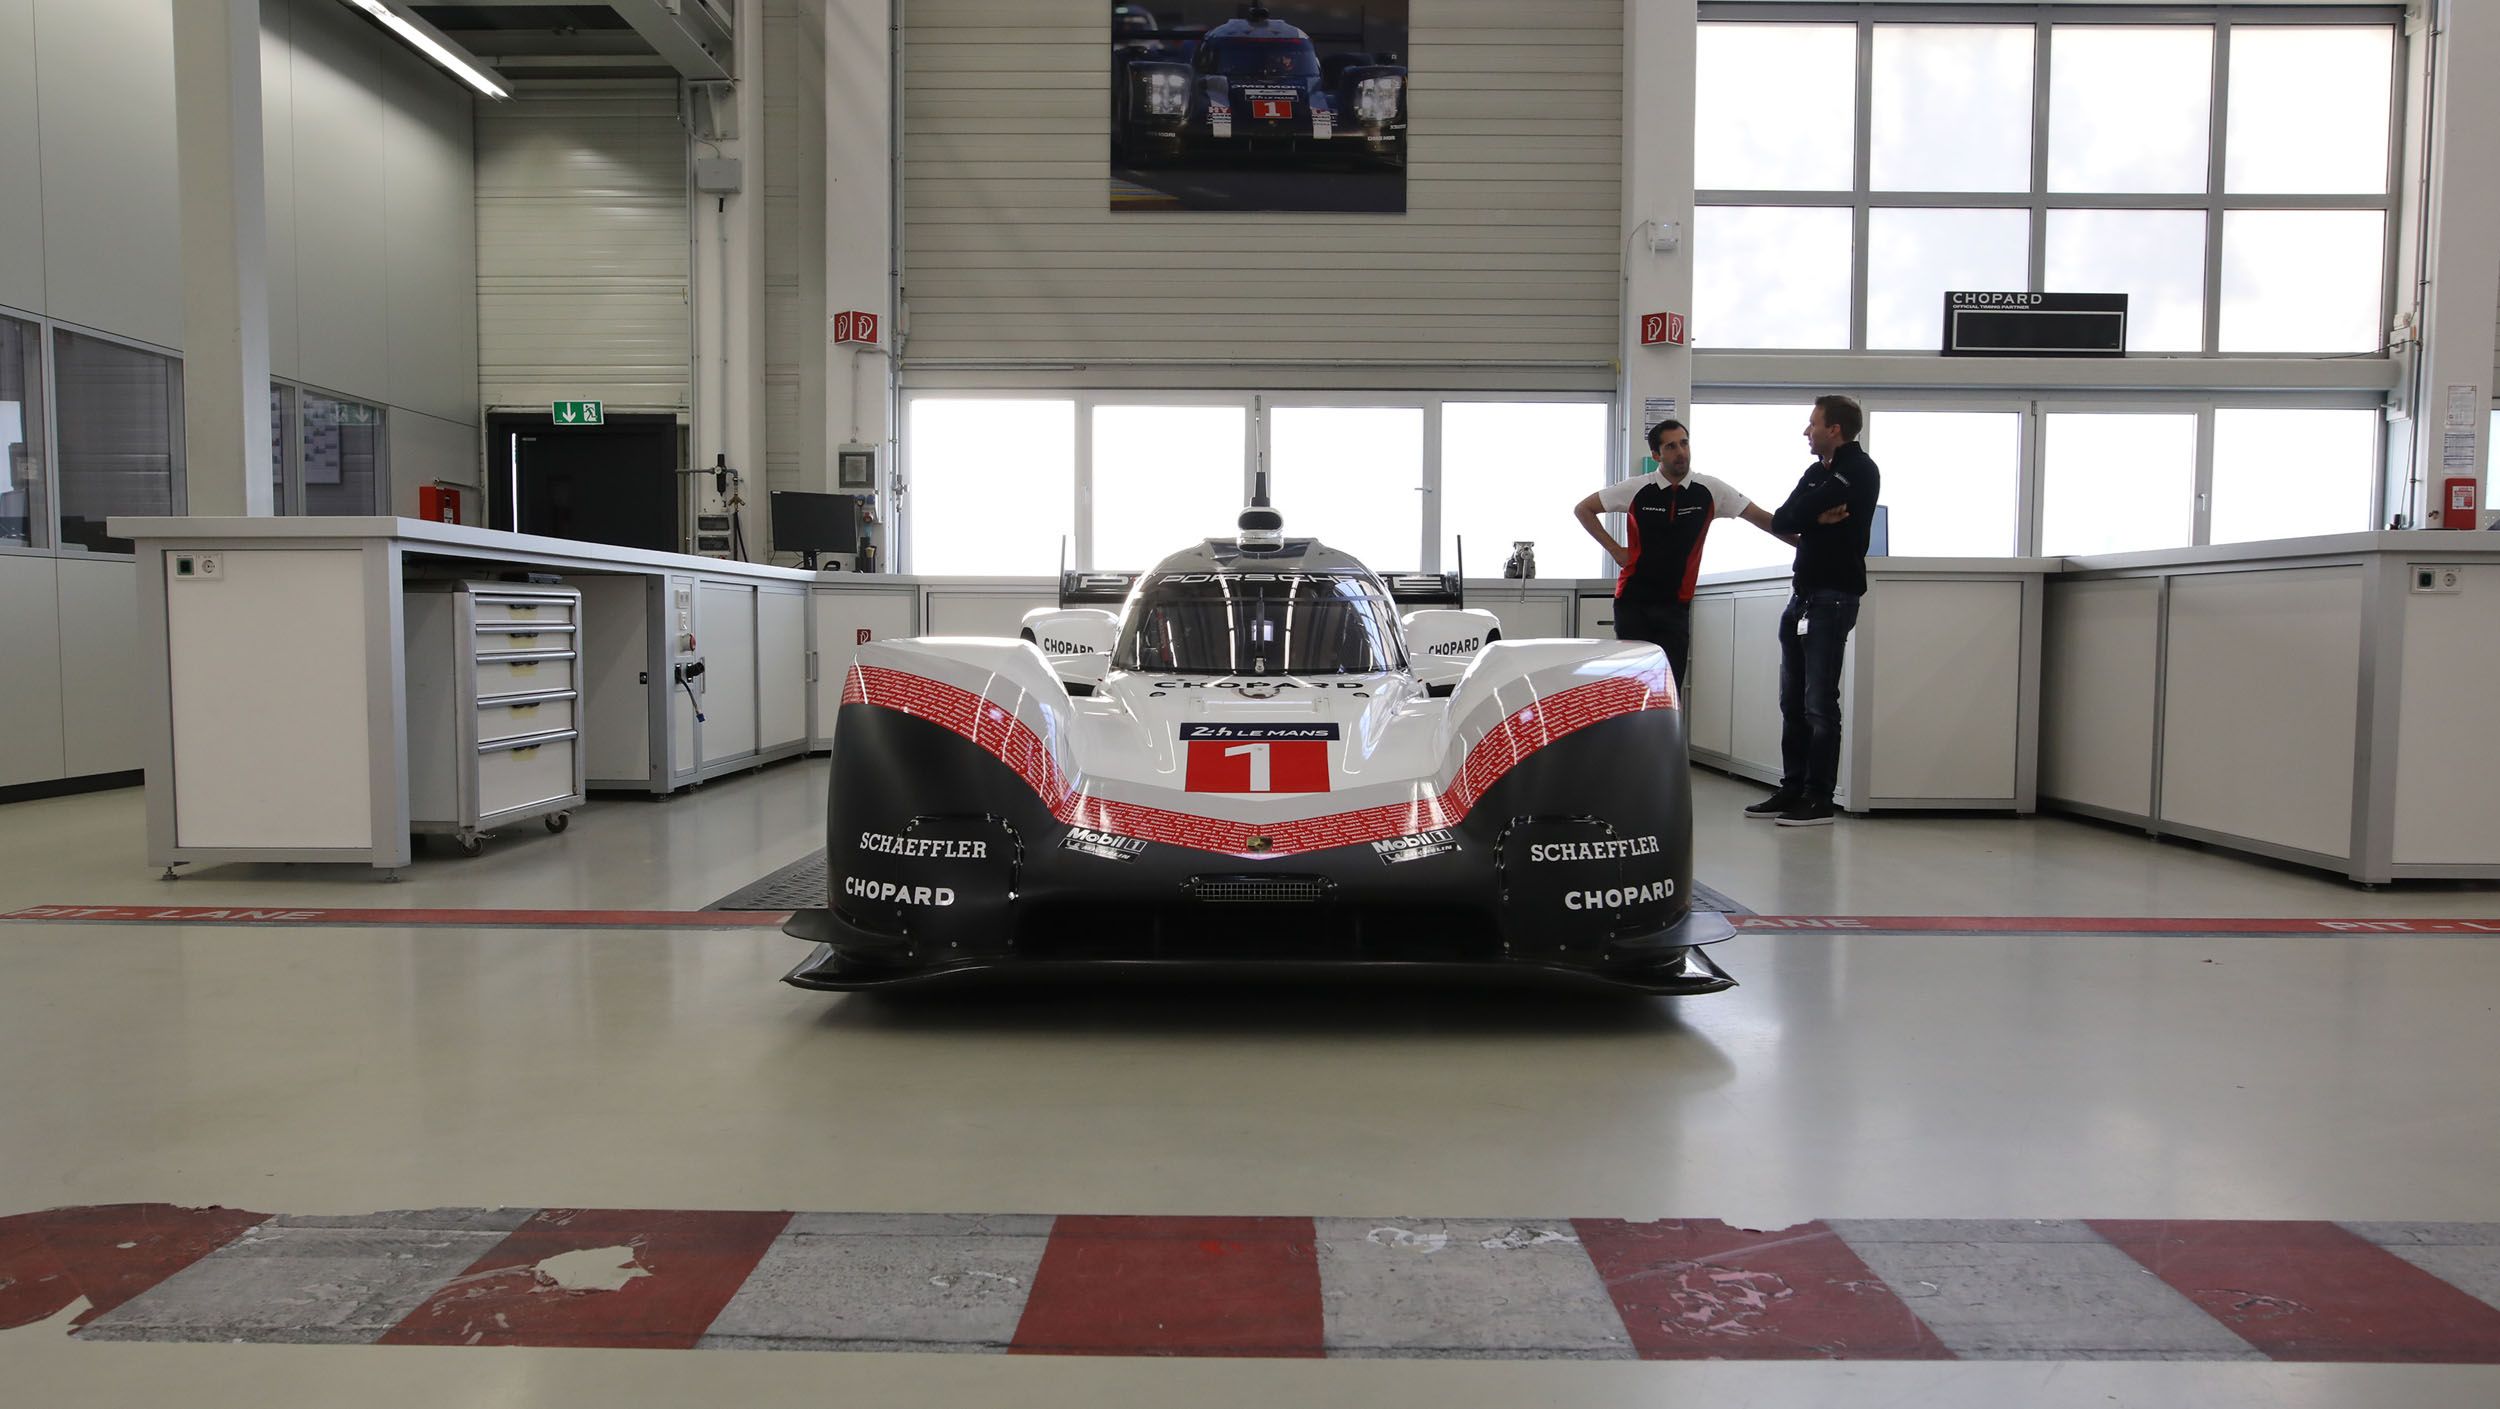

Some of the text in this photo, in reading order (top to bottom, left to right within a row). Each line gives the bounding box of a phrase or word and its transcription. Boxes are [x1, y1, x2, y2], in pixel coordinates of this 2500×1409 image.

[1263, 101, 1281, 117] 1
[1953, 293, 2042, 304] CHOPARD
[1158, 574, 1358, 585] PORSCHE
[1153, 681, 1364, 689] CHOPARD
[1224, 743, 1271, 792] 1
[859, 831, 987, 859] SCHAEFFLER
[1066, 827, 1127, 848] Mobil
[1371, 833, 1432, 853] Mobil
[1531, 835, 1660, 862] SCHAEFFLER
[845, 876, 955, 906] CHOPARD
[1564, 878, 1675, 910] CHOPARD
[149, 910, 325, 919] LANE
[1732, 918, 1871, 928] ANE
[2316, 922, 2416, 930] PIT
